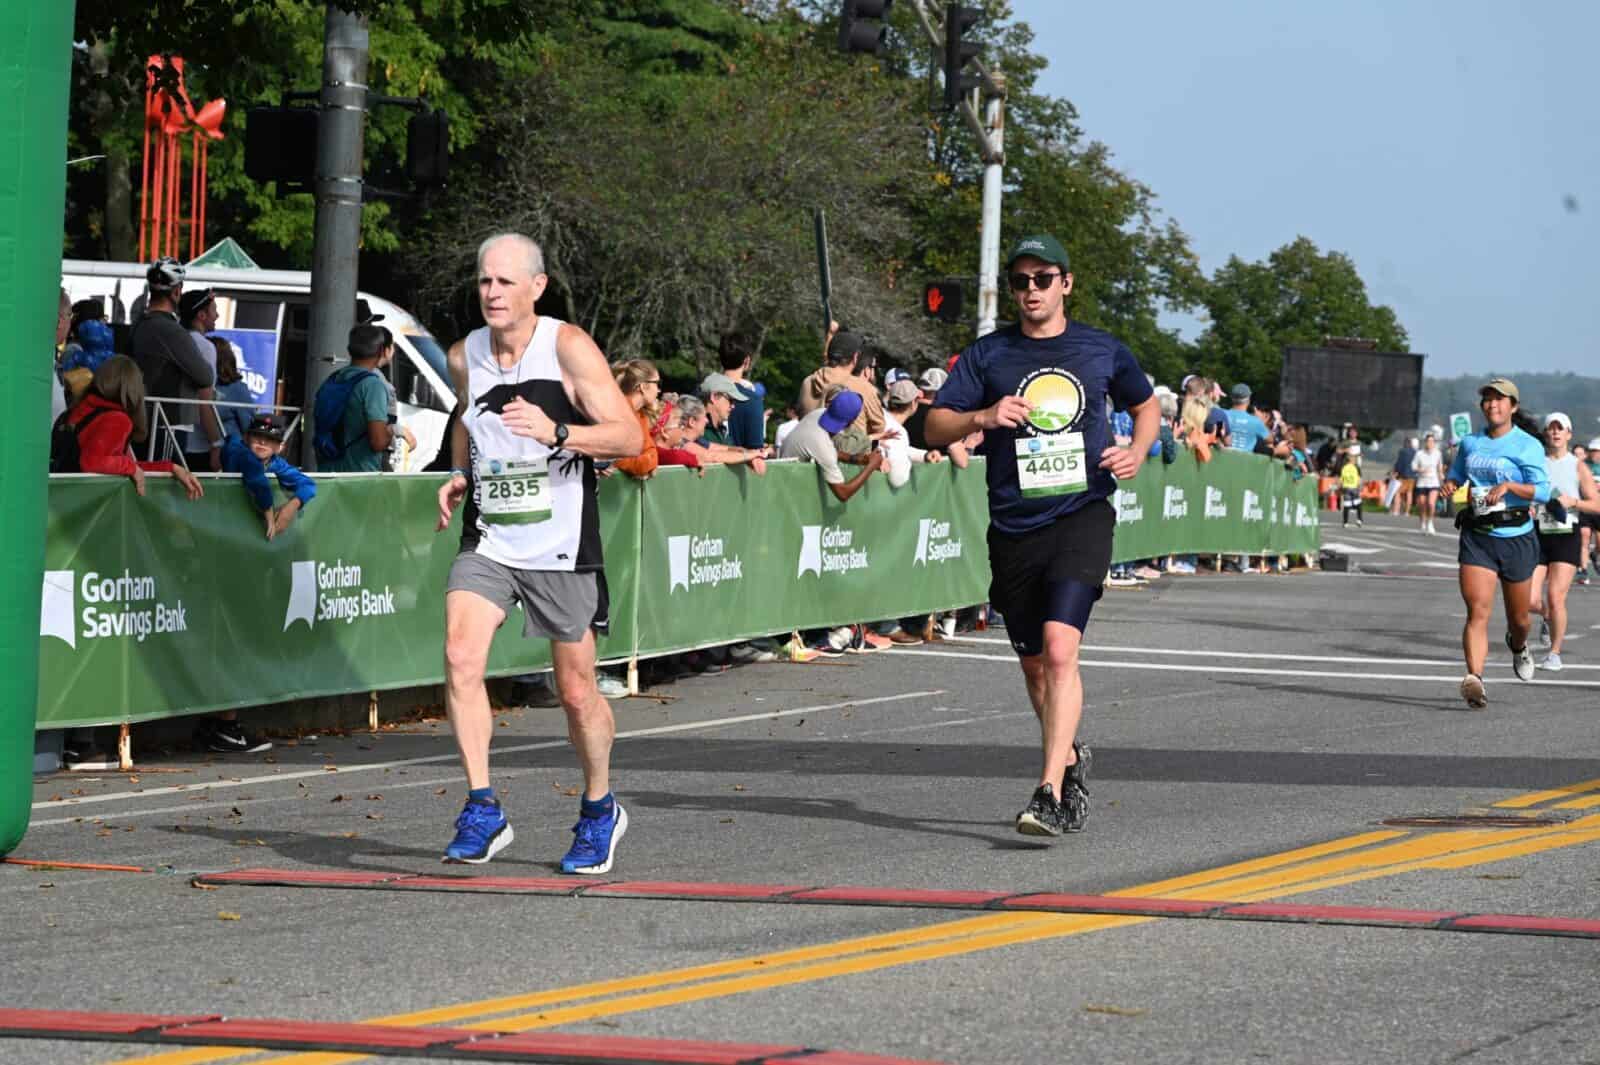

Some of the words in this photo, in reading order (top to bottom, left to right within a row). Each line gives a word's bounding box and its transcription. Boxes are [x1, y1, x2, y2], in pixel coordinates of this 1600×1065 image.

[1025, 455, 1078, 475] 4405
[488, 479, 540, 499] 2835
[691, 532, 723, 559] Gorham
[822, 524, 852, 548] Gorham
[317, 559, 361, 590] Gorham
[690, 558, 722, 587] Savings
[721, 553, 743, 580] Bank
[822, 548, 850, 575] Savings
[849, 545, 868, 569] Bank
[81, 569, 155, 602] Gorham
[318, 590, 359, 624] Savings
[361, 586, 395, 616] Bank
[81, 605, 153, 642] Savings
[155, 600, 187, 634] Bank
